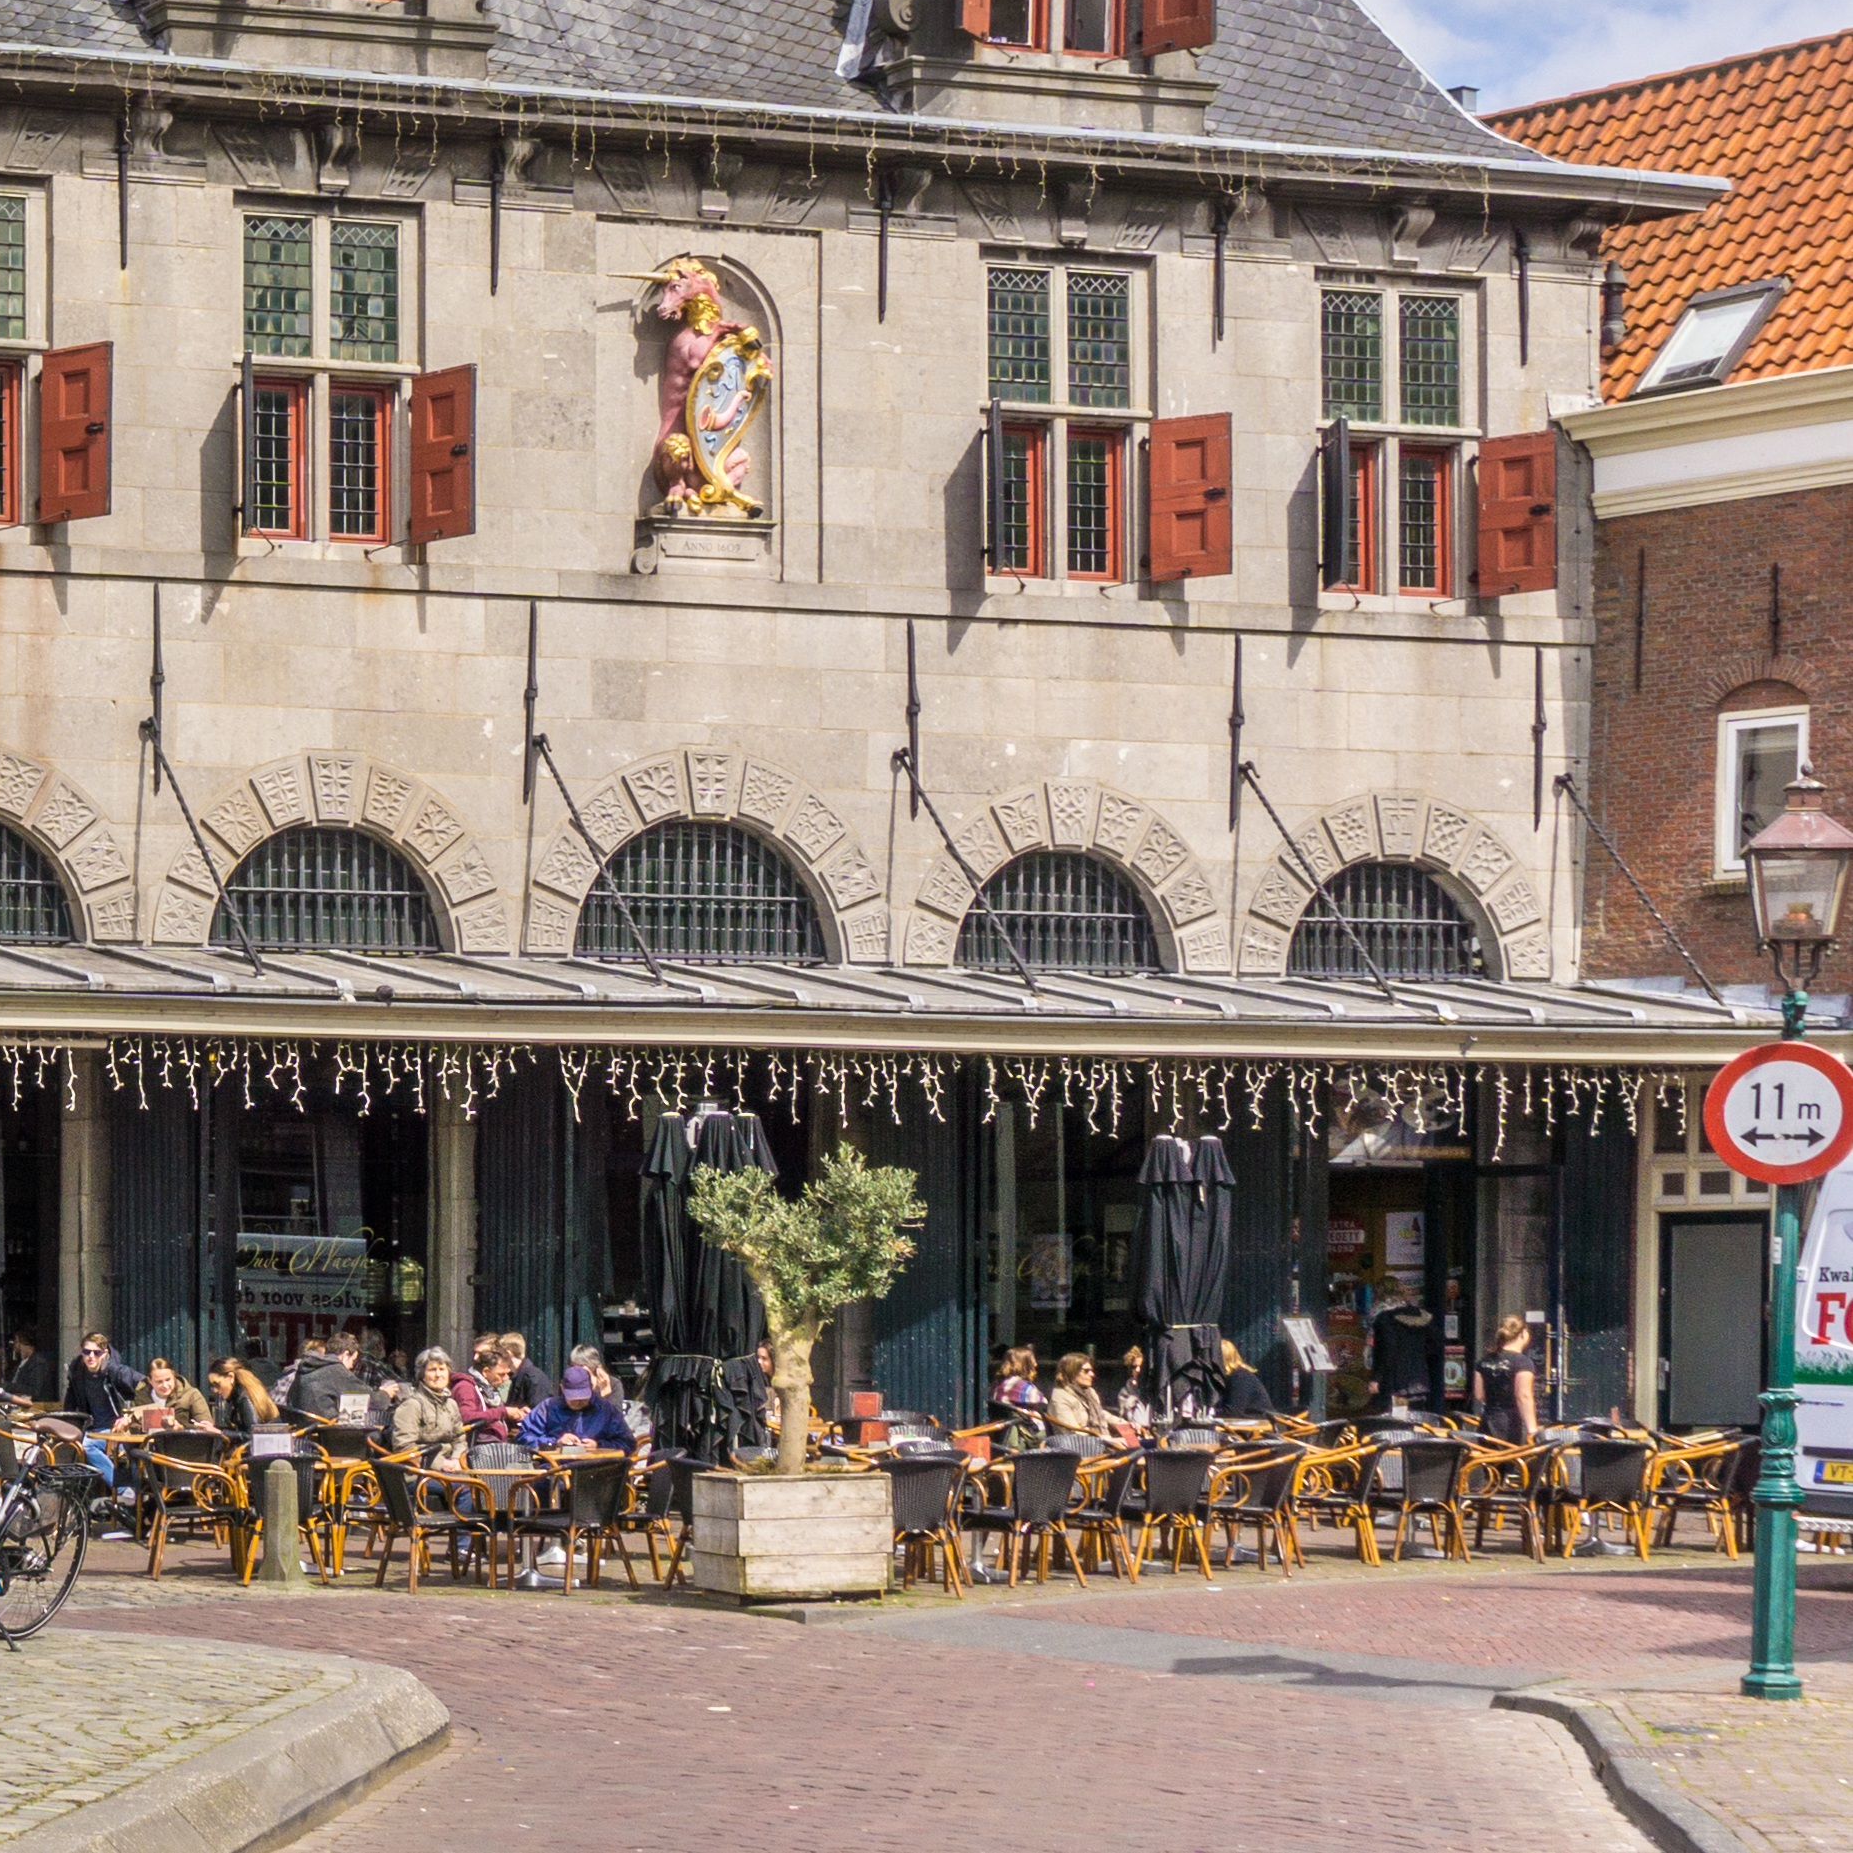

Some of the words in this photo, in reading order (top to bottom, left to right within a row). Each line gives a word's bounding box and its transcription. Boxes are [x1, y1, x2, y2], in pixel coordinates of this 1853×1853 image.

[683, 541, 713, 552] ANNO
[1751, 1082, 1784, 1120] 11
[1798, 1103, 1821, 1120] m
[1818, 1267, 1853, 1282] Kwa
